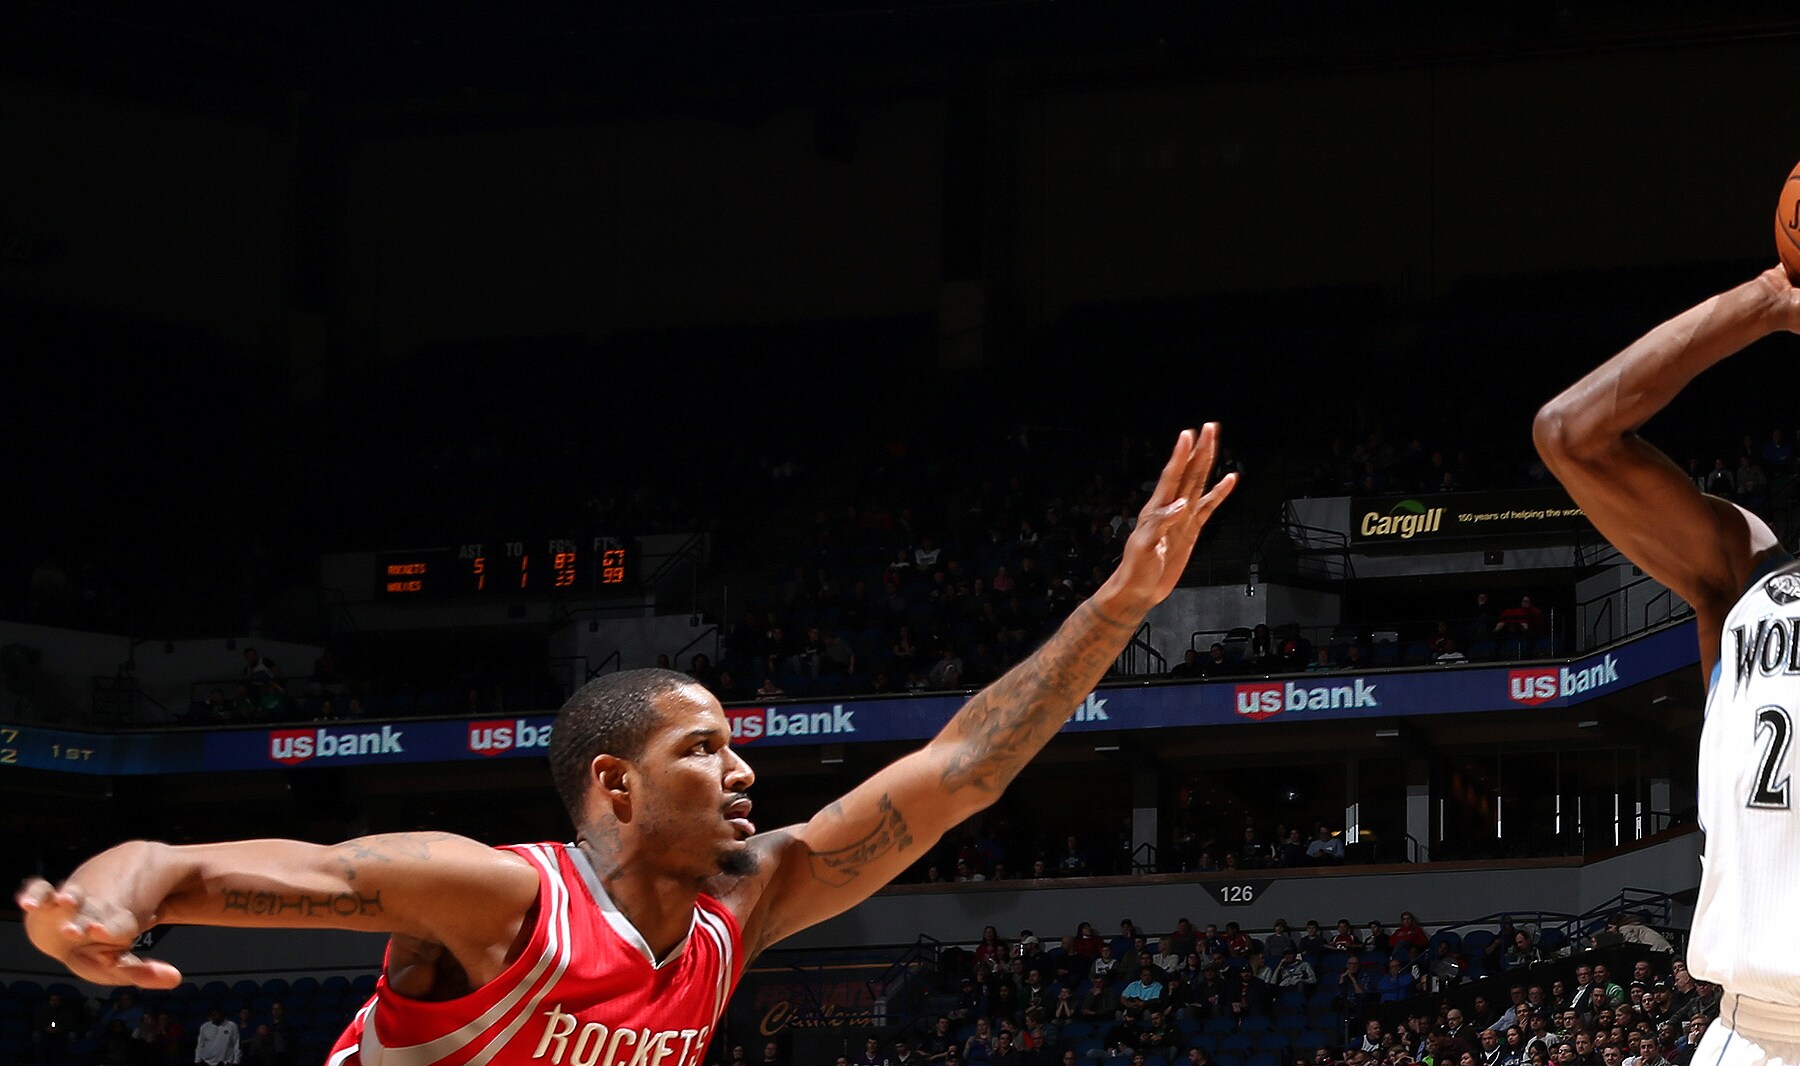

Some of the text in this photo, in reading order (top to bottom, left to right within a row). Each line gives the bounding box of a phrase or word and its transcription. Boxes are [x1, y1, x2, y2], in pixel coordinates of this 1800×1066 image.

[1546, 508, 1561, 517] the
[1361, 508, 1443, 540] Cargill
[505, 542, 523, 556] TO
[472, 557, 487, 574] 5
[521, 555, 529, 571] 1
[477, 574, 485, 591] 1
[521, 572, 528, 589] 1
[1220, 885, 1253, 903] 126
